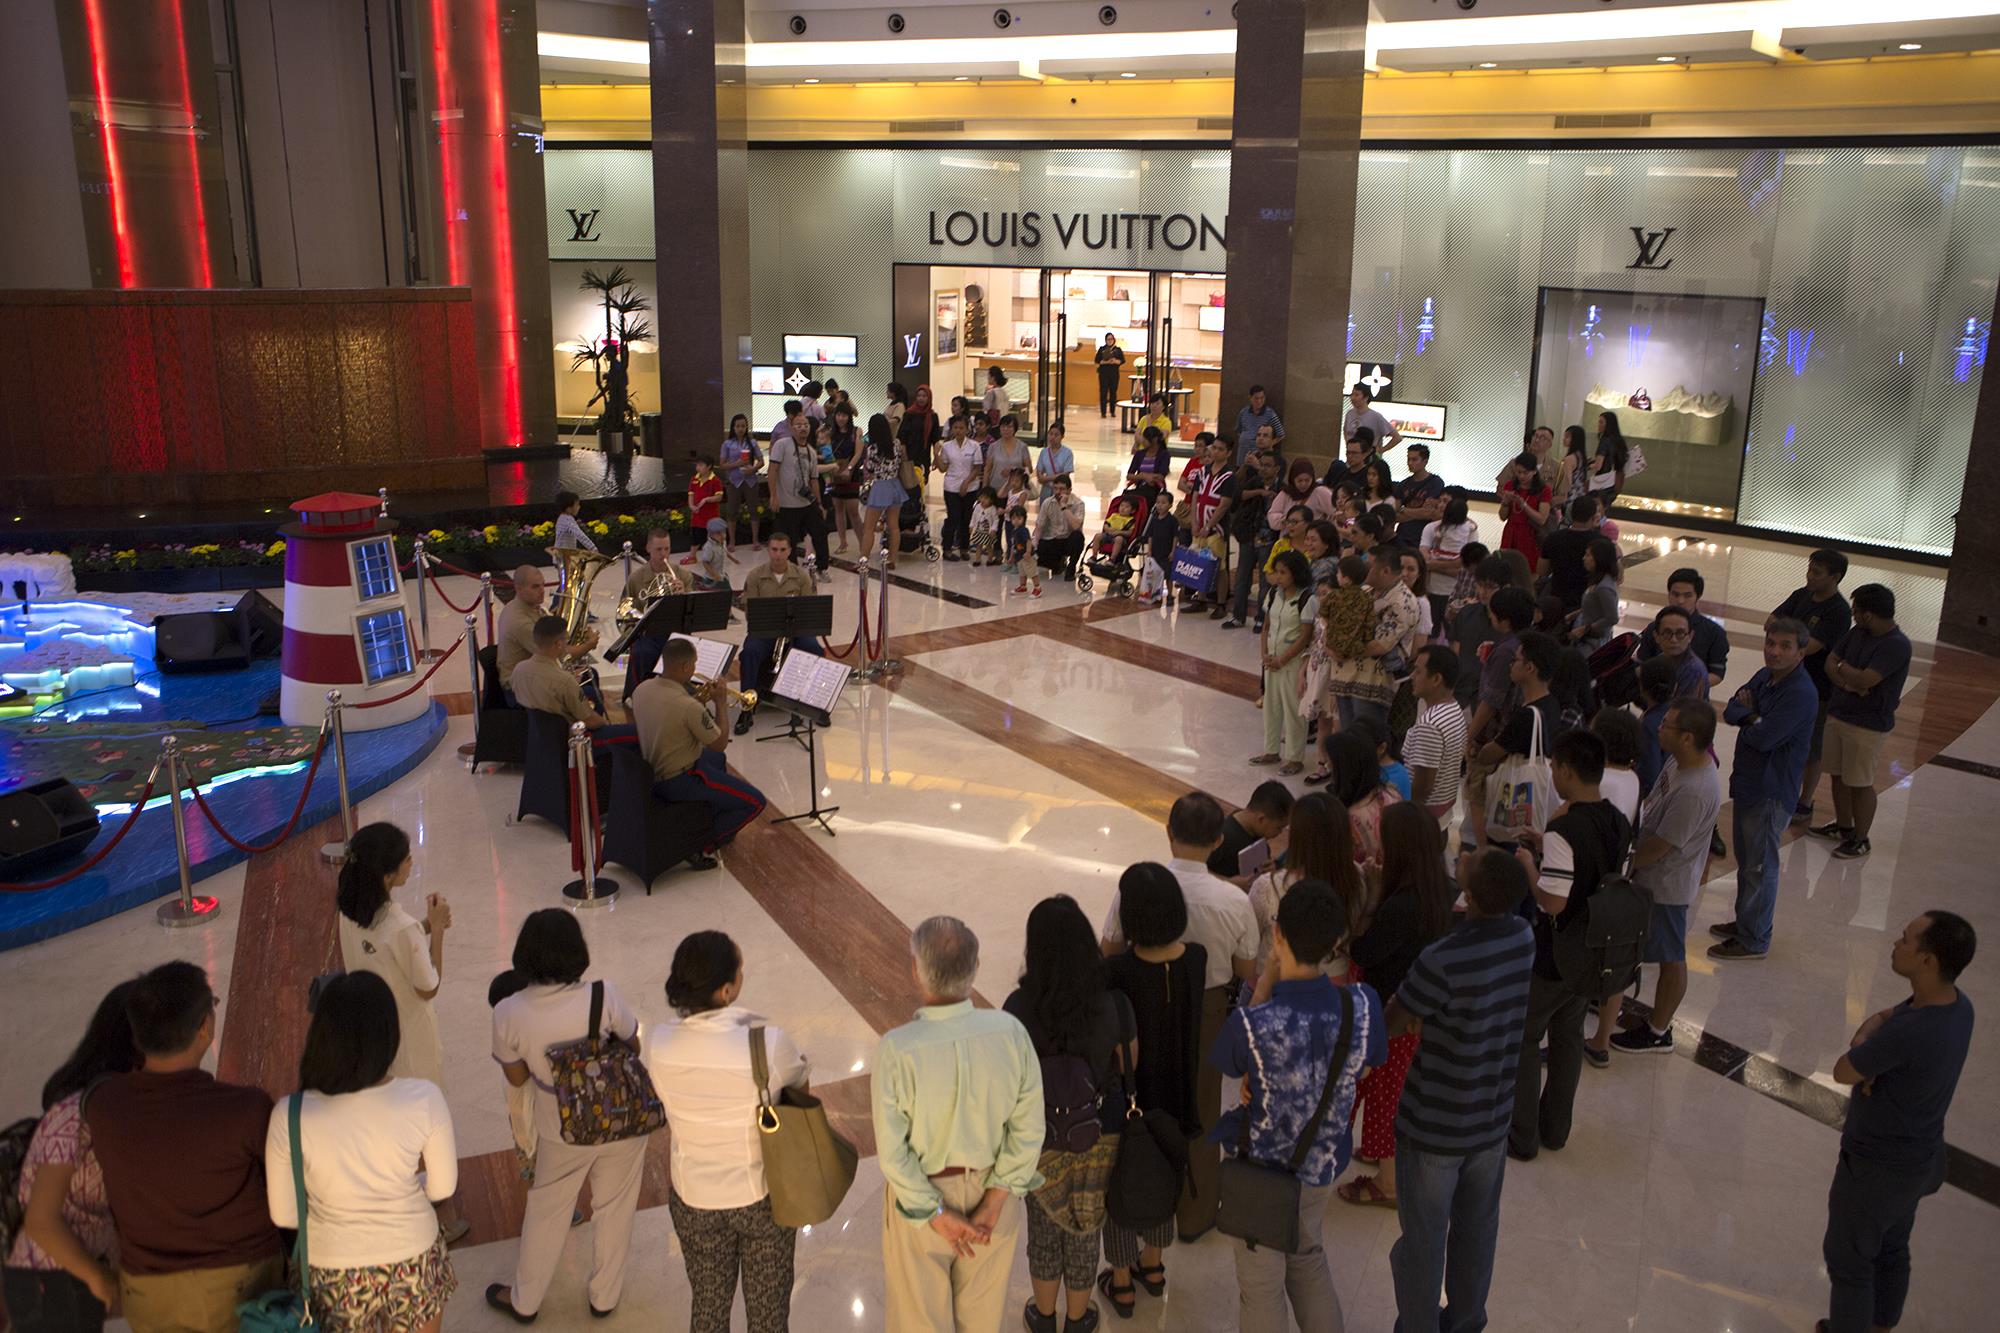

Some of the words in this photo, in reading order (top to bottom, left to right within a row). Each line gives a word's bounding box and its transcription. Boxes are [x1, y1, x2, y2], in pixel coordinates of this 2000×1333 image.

[566, 208, 601, 242] LV
[929, 210, 1041, 249] LOUIS
[1052, 212, 1226, 251] VUITTON
[1626, 227, 1676, 269] LV
